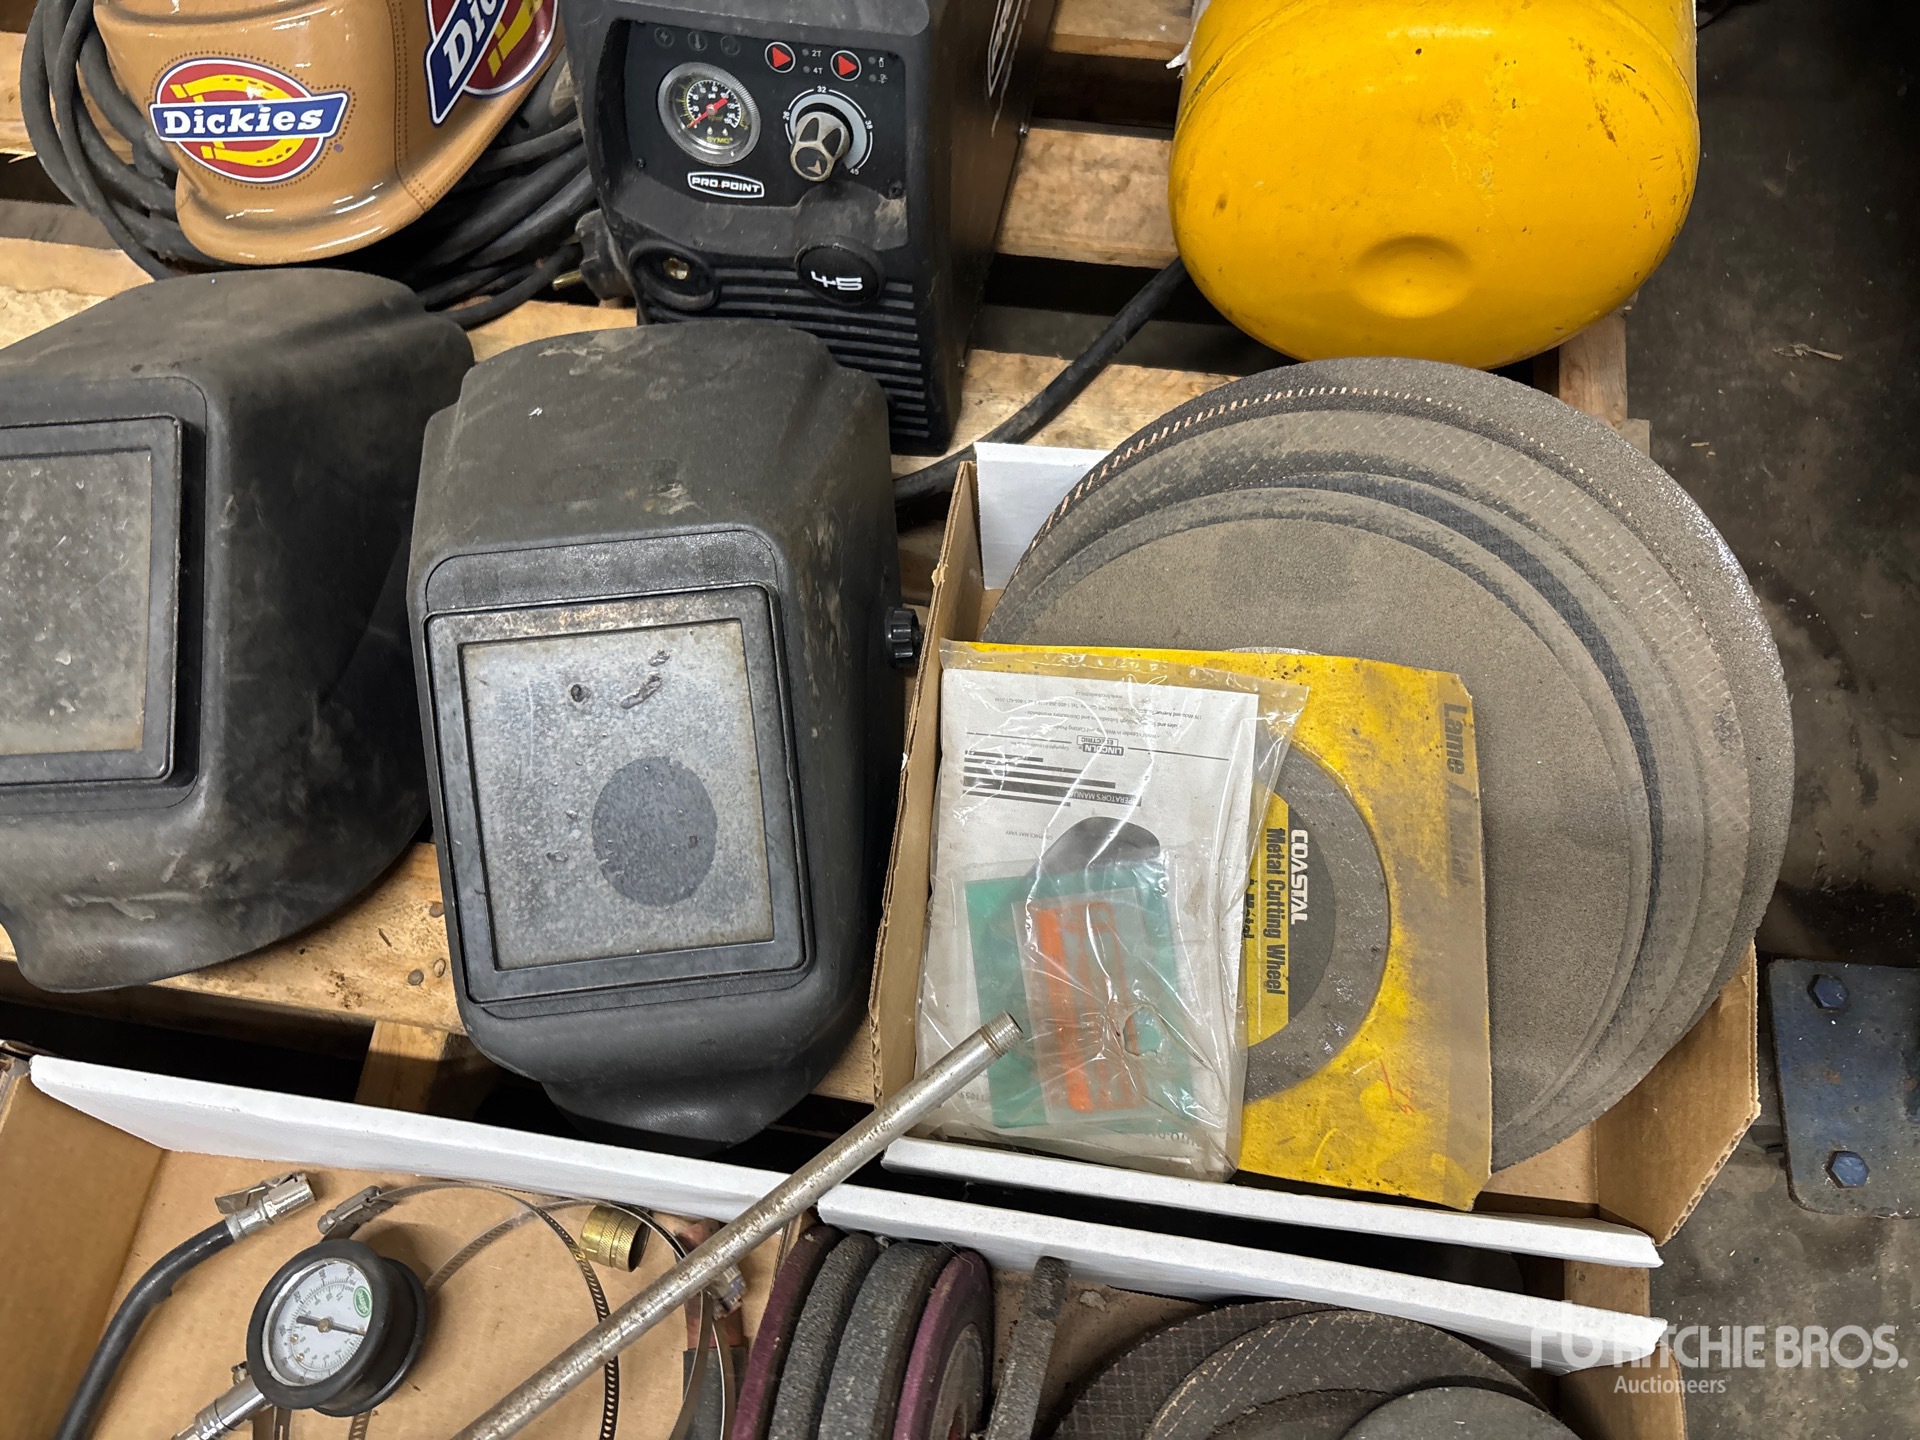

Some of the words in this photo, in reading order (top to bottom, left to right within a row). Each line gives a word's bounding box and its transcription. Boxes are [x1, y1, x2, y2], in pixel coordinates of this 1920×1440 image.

[811, 49, 822, 58] 2T
[813, 67, 823, 75] 4T
[816, 85, 827, 93] 32
[163, 106, 325, 135] Dickies
[850, 168, 860, 176] 45
[810, 270, 864, 292] 45
[1084, 744, 1122, 756] LINCOLN
[1444, 703, 1468, 776] Lame
[1266, 828, 1286, 875] Metal
[1291, 829, 1309, 925] COASTAL
[1263, 879, 1286, 940] Cutting
[1266, 944, 1286, 995] Wheel
